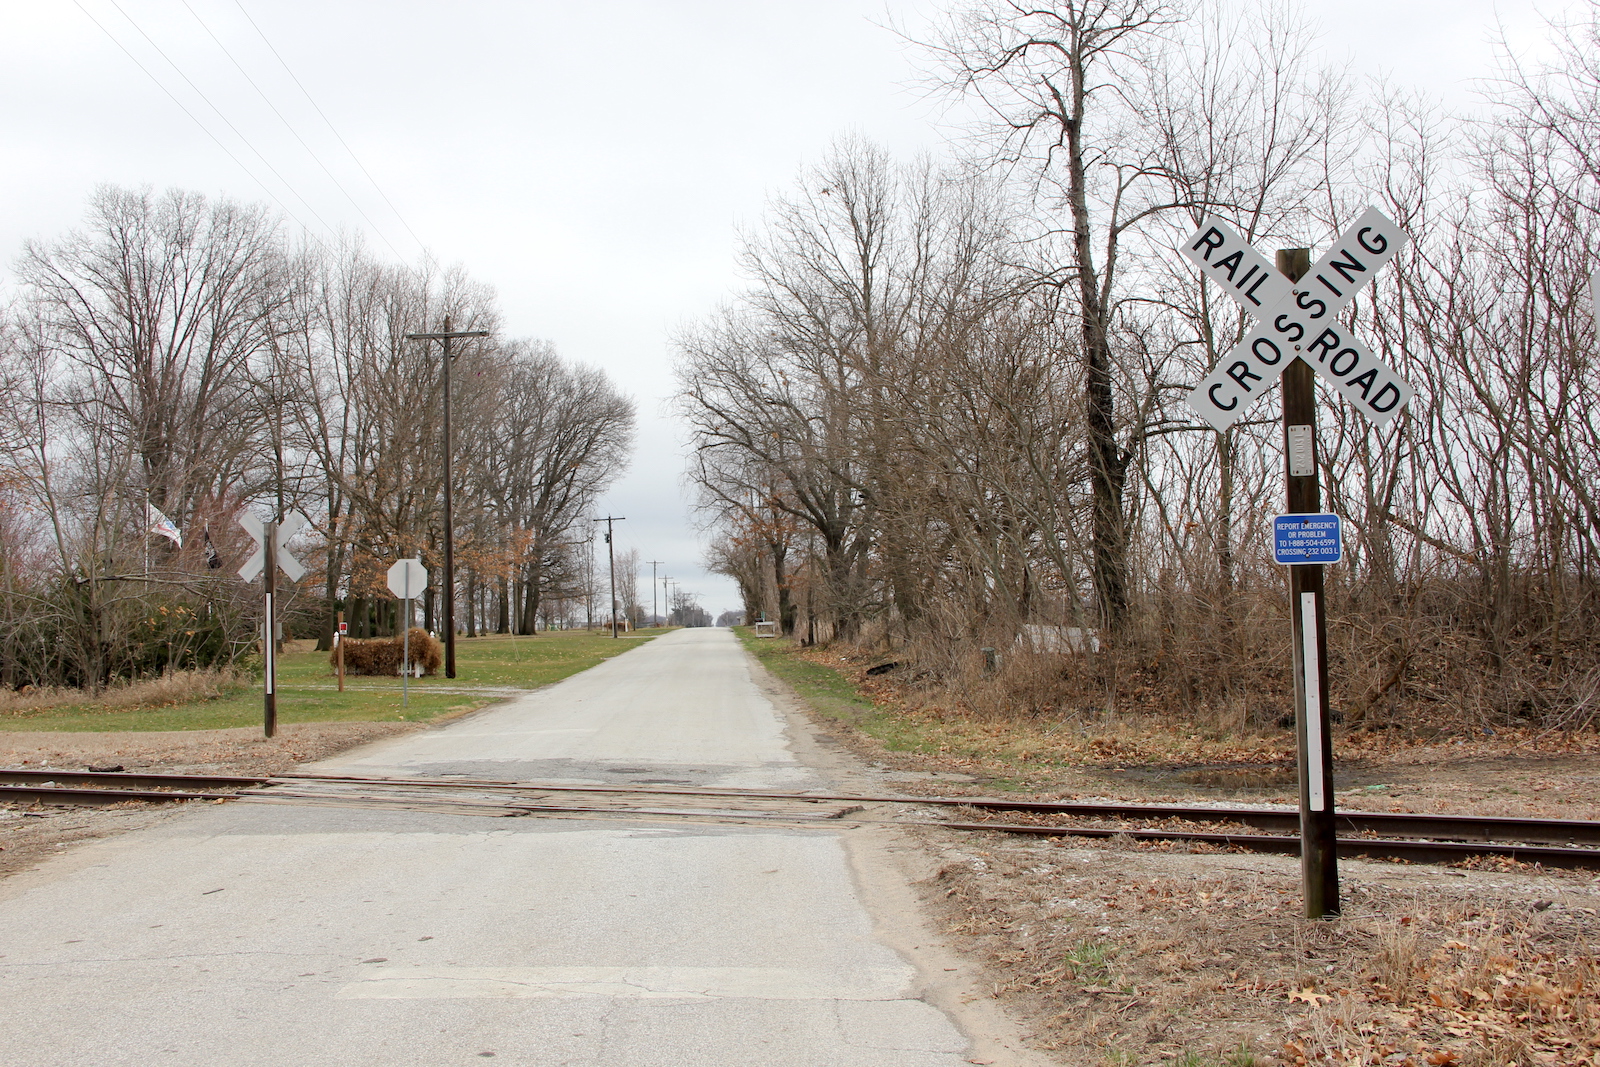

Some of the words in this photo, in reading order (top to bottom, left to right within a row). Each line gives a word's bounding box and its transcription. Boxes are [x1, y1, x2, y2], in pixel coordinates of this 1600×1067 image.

[1191, 226, 1269, 307] RAIL
[1208, 227, 1388, 411] CROSSING
[1306, 327, 1401, 413] ROAD
[1288, 539, 1336, 547] 1-888-504-6599
